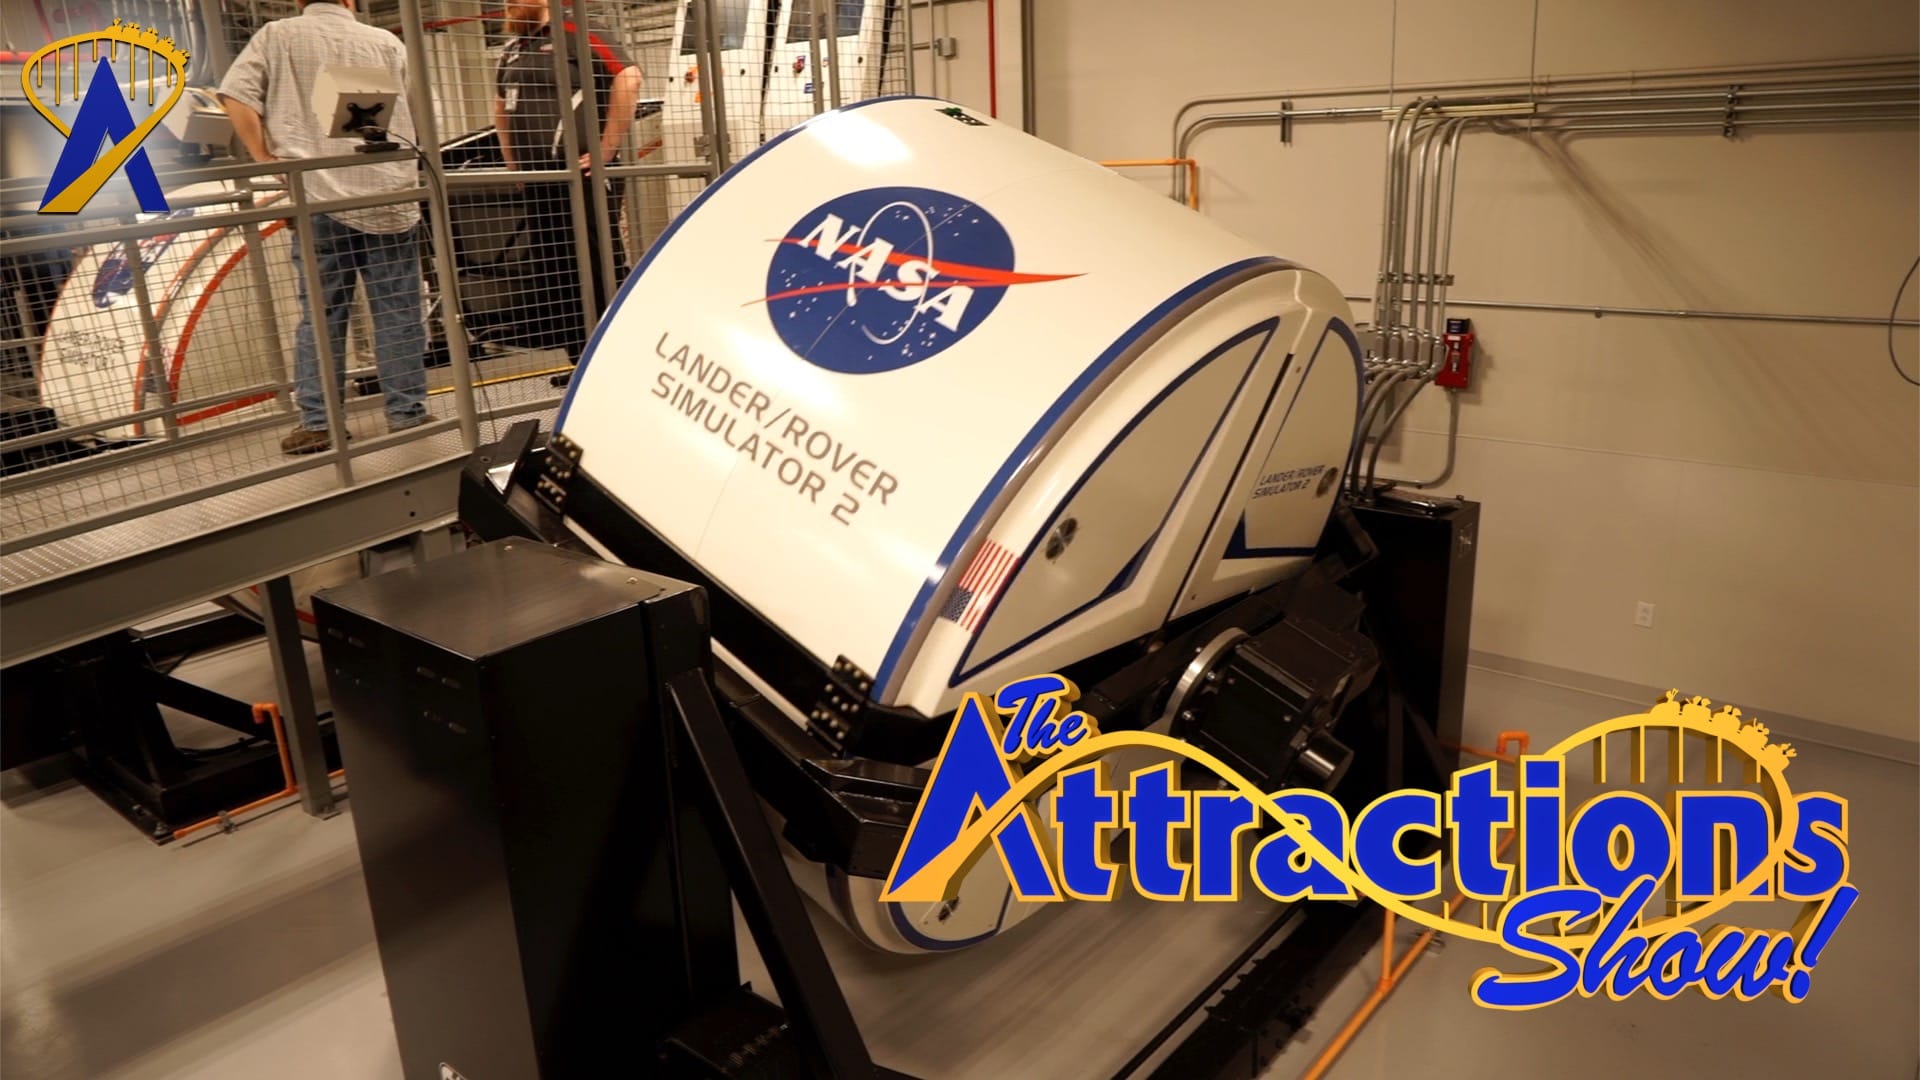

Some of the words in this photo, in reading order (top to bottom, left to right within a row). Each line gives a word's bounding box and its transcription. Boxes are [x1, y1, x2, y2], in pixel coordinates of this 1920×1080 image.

[797, 213, 975, 332] NASA
[651, 371, 827, 504] SIMULATOR
[830, 492, 861, 527] 2
[655, 332, 899, 506] LANDER/ROVER
